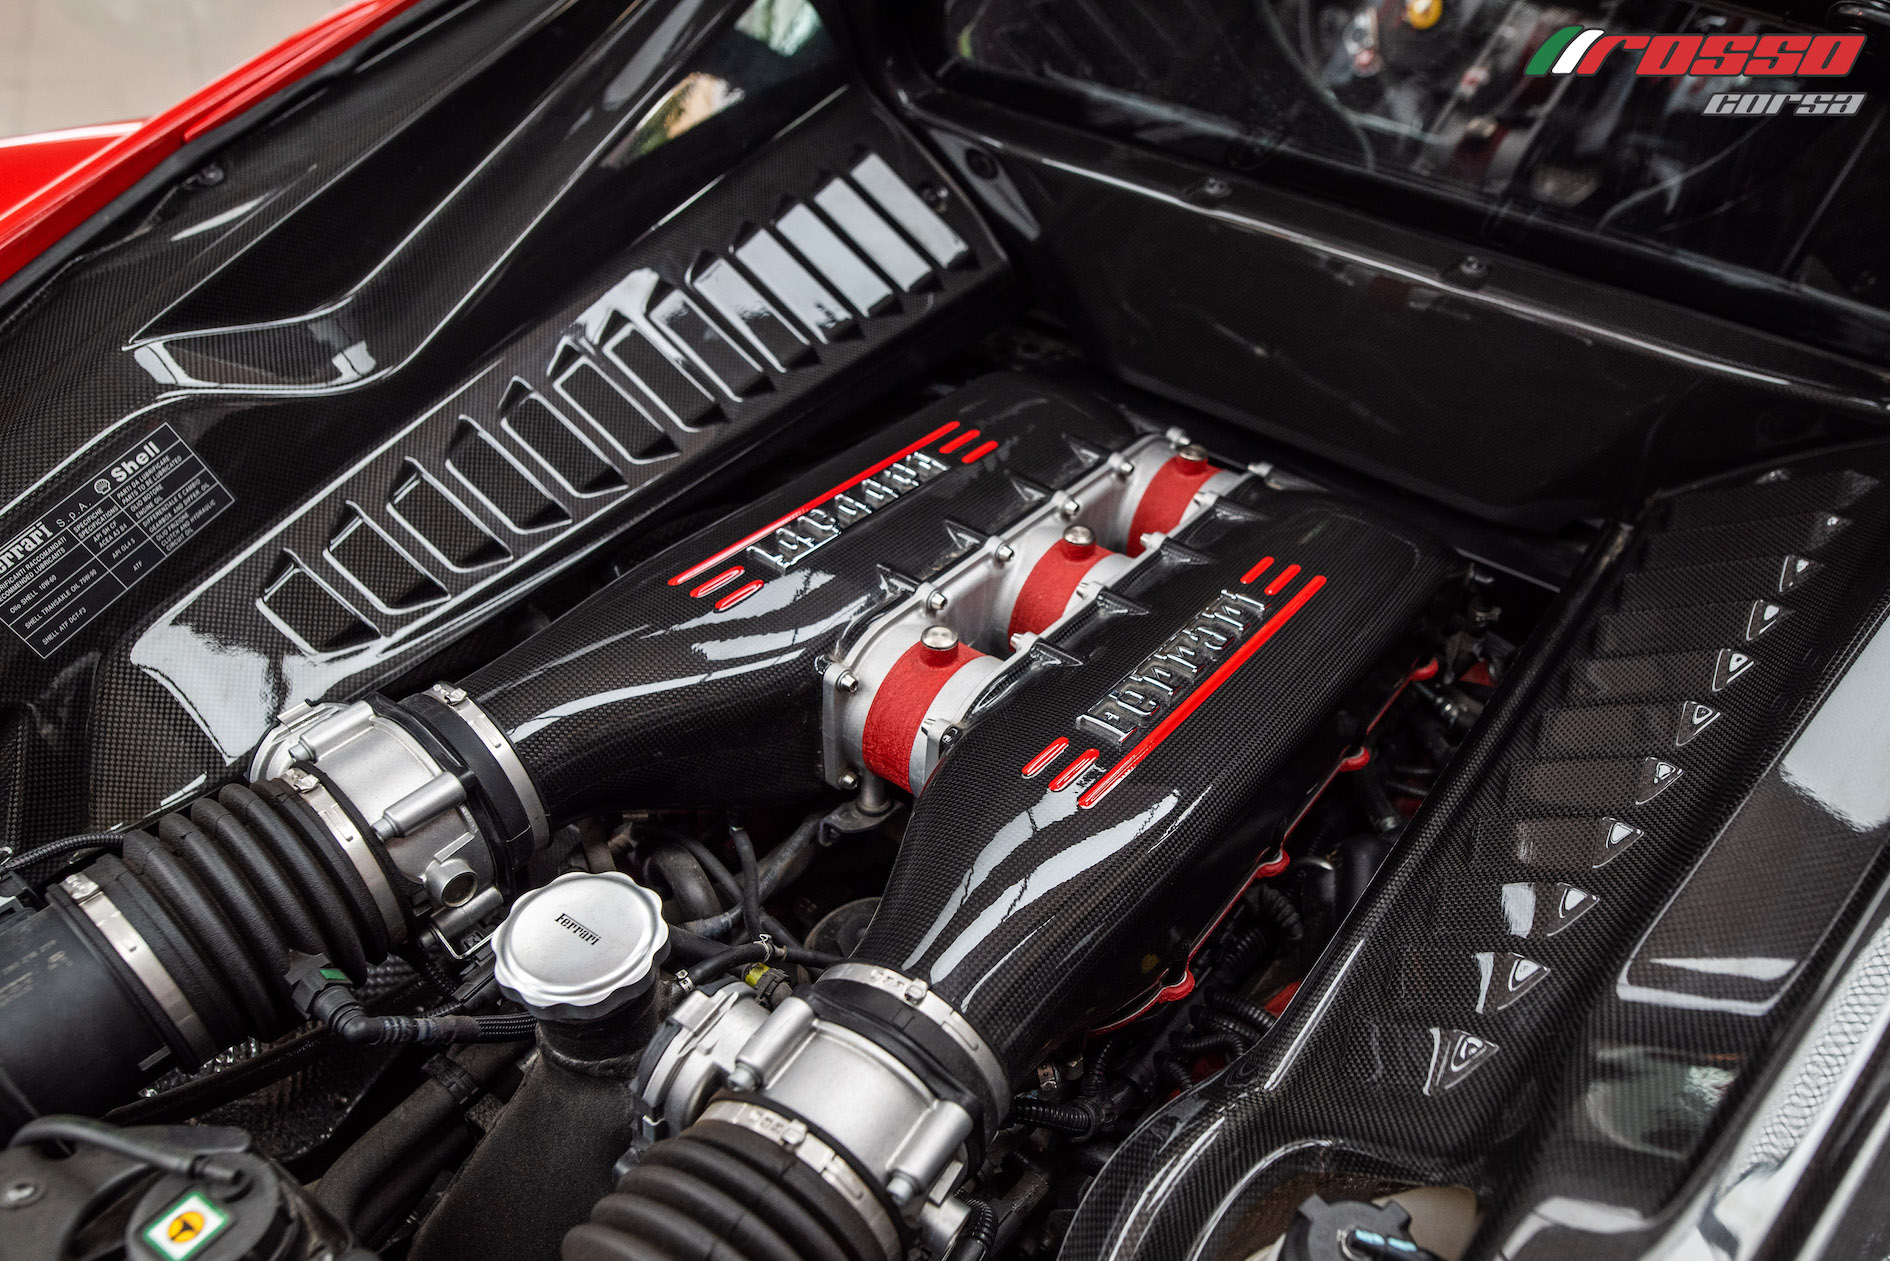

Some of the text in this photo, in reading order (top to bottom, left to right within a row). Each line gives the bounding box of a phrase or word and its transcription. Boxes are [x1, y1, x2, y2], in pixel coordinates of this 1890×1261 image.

[111, 440, 161, 482] Shell
[116, 485, 132, 500] PARTI
[121, 490, 139, 505] PARTS
[138, 483, 146, 492] TO
[152, 455, 182, 481] LUBRICATED
[130, 483, 163, 512] OLIO MOTORE
[56, 502, 92, 528] S.p.A.
[73, 507, 103, 533] SPECIFICHE
[78, 505, 119, 539] SPECIFICATIONS
[25, 536, 67, 571] RACCOMANDATI
[98, 534, 114, 549] ACEA
[160, 528, 180, 547] CLUTCH
[0, 547, 66, 602] ECOMMENDED LUBRICANTS
[132, 559, 143, 571] ATF
[9, 574, 57, 614] Olio SHELL 10W-60
[24, 568, 98, 629] SHELL TRANSAXLE OIL 75W-90
[41, 606, 87, 646] SHELL ATF DCT-F3
[1076, 589, 1268, 747] Ferrari
[554, 913, 602, 946] Ferrari
